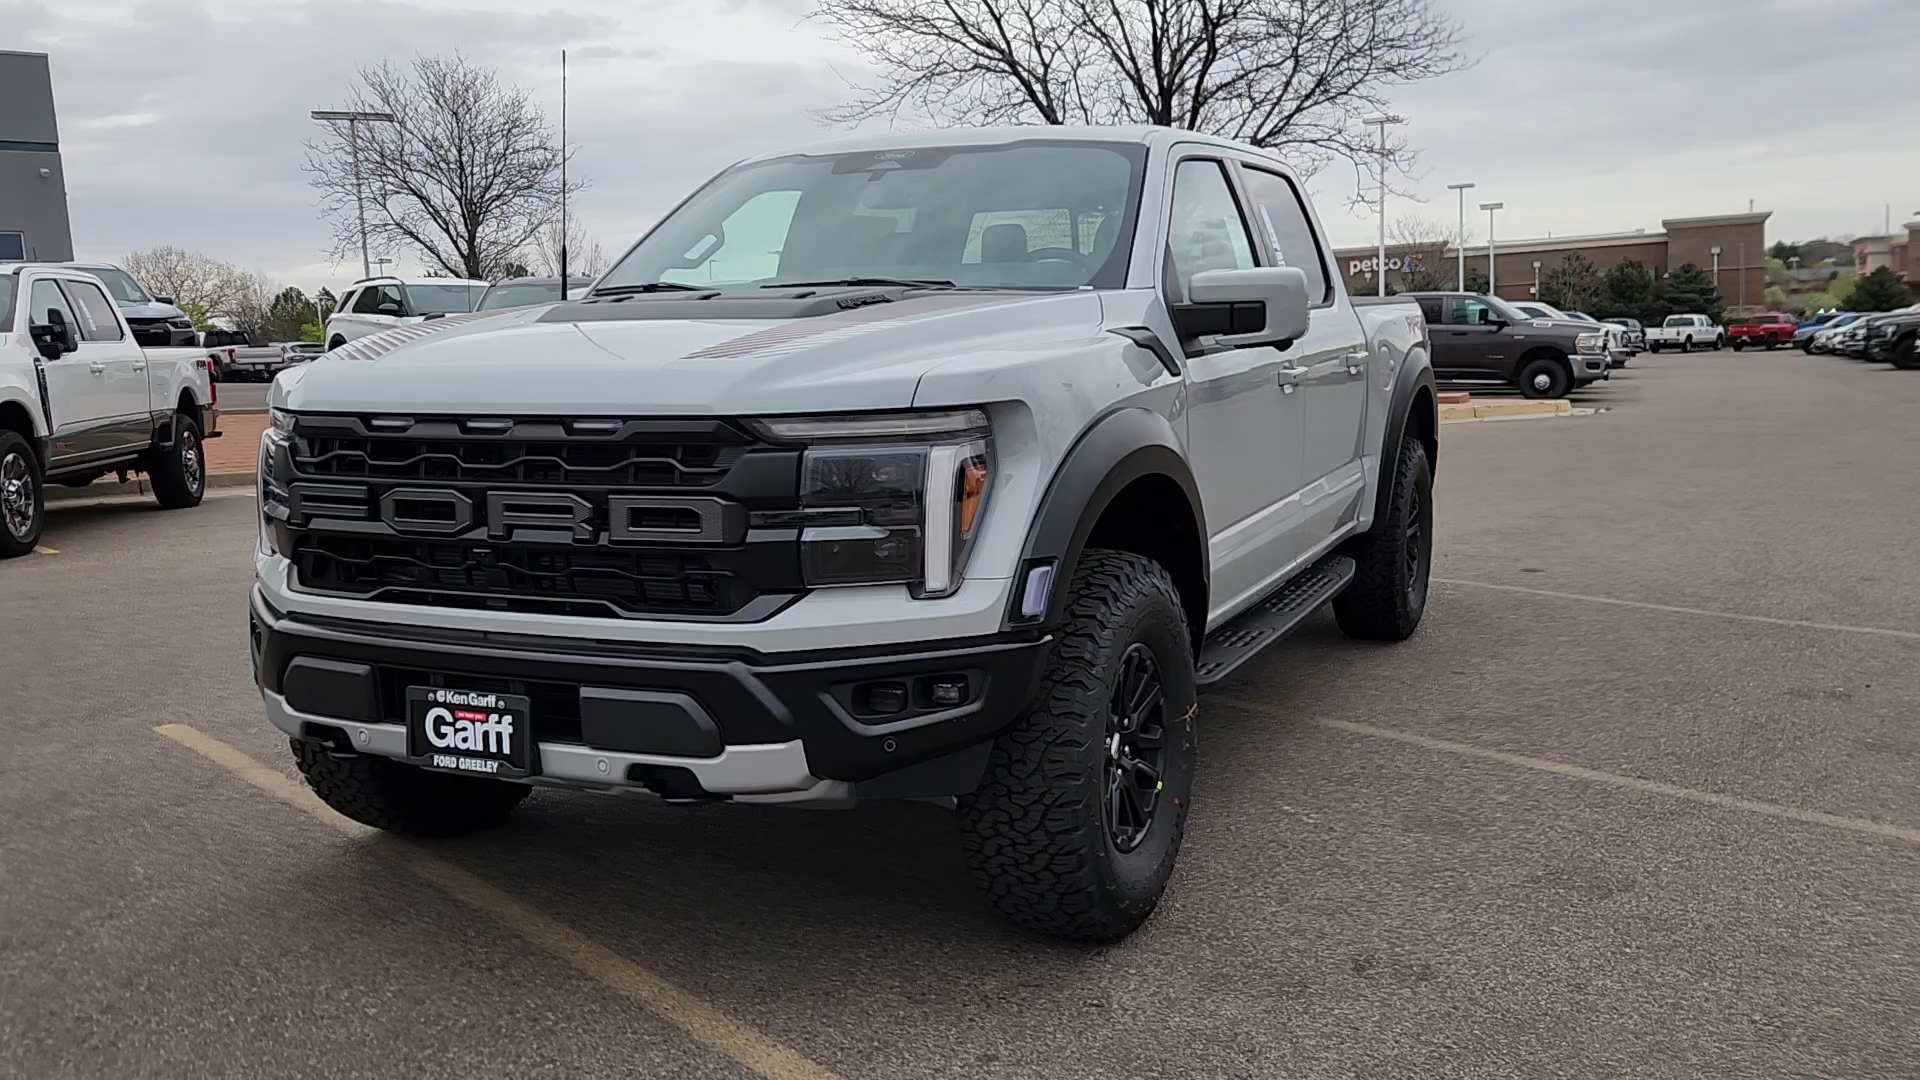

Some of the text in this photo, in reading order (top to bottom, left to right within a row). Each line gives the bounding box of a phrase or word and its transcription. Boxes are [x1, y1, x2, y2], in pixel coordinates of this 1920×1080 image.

[289, 482, 740, 547] FORD
[445, 691, 497, 708] Ken Garff
[425, 707, 513, 754] Garff
[433, 755, 498, 773] FORD GREELEY
